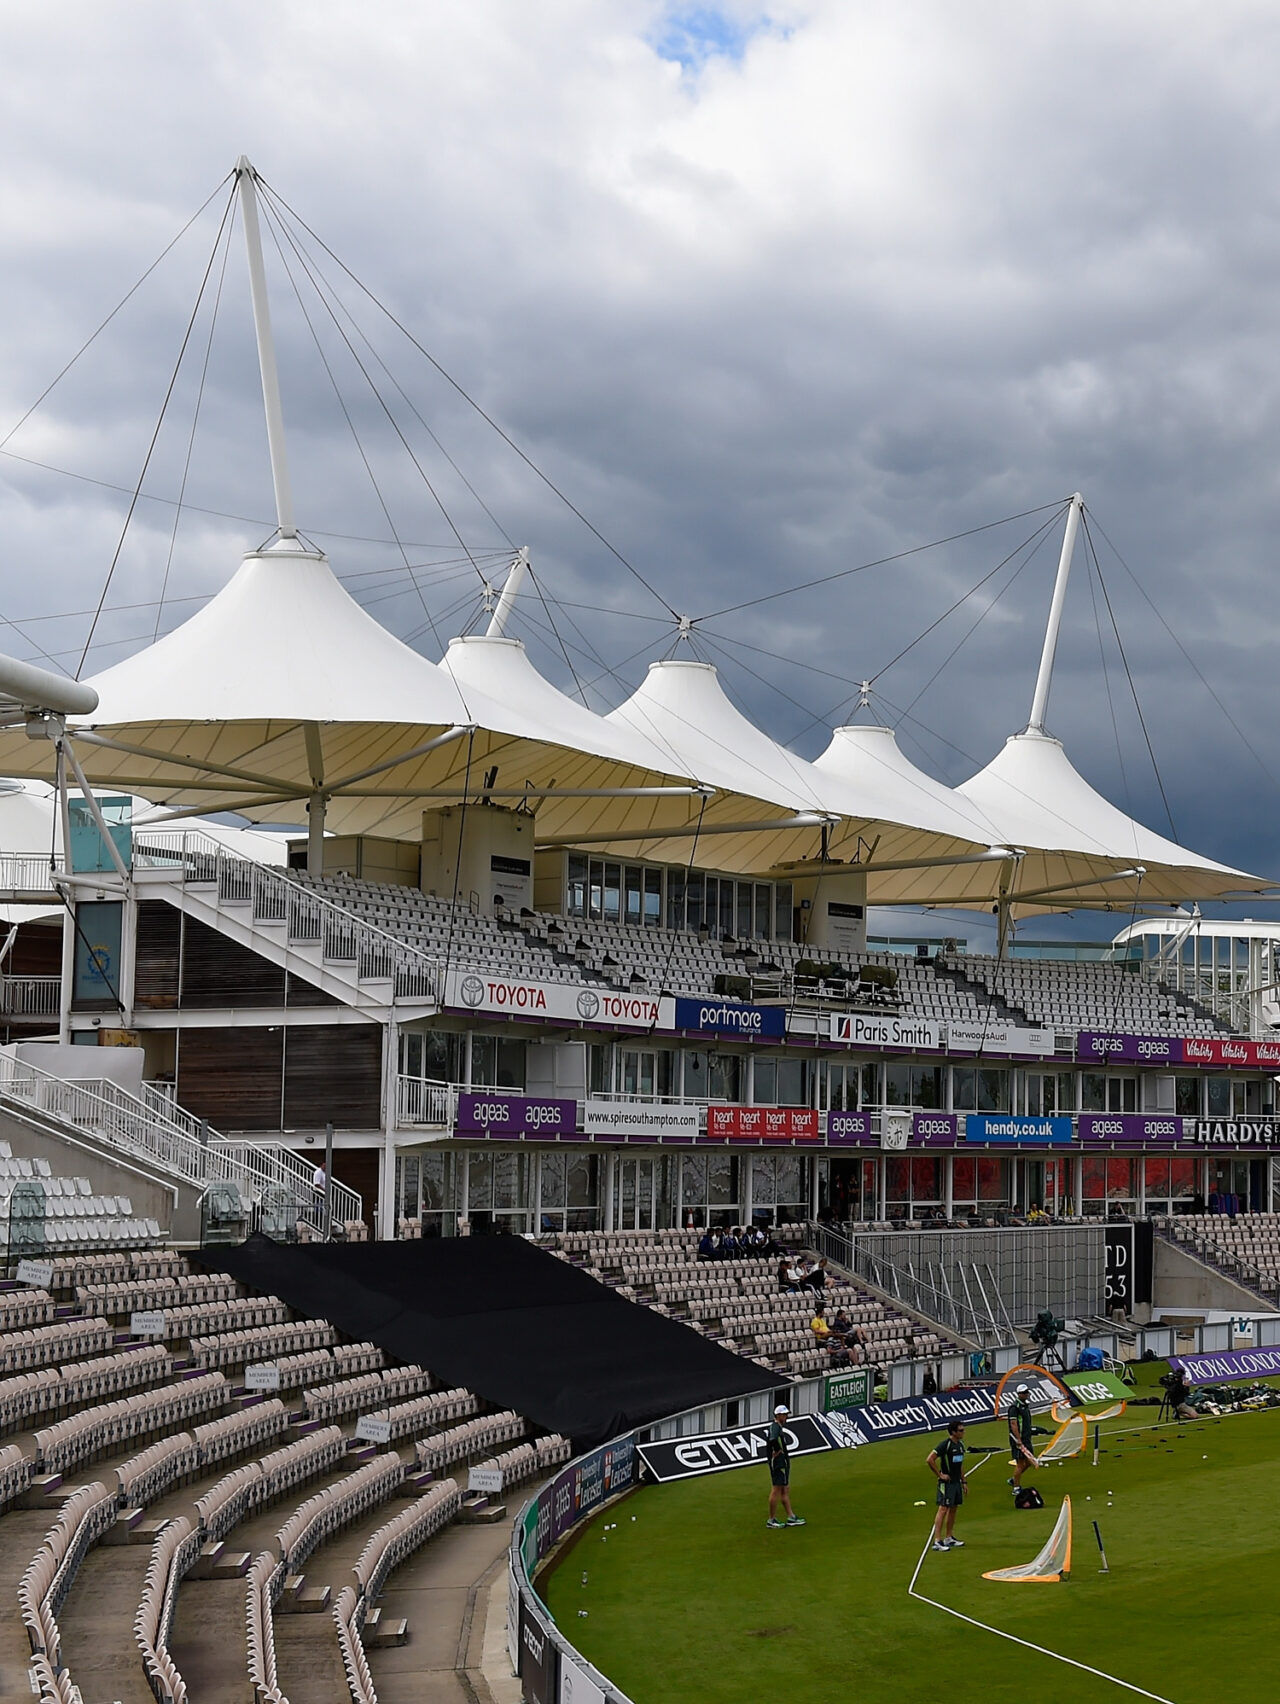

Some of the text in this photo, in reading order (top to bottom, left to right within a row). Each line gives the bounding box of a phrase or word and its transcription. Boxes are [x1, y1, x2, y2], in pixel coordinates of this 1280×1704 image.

[488, 983, 546, 1010] TOYOTA
[602, 997, 659, 1021] TOYOTA
[700, 1004, 762, 1028] portmore
[855, 1018, 932, 1046] Paris Smith
[1091, 1038, 1124, 1055] ageas
[1138, 1041, 1170, 1059] ageas
[1187, 1040, 1213, 1061] Vitality
[1221, 1042, 1248, 1063] Vitality
[473, 1103, 510, 1128] ageas
[525, 1105, 561, 1130] ageas
[588, 1111, 696, 1128] www.spiresouthampton.com
[713, 1109, 734, 1123] heart
[740, 1110, 760, 1124] heart
[766, 1111, 786, 1125] heart
[792, 1112, 812, 1125] heart
[832, 1117, 865, 1138] ageas
[917, 1119, 951, 1139] ageas
[985, 1120, 1053, 1138] hendy.co.uk
[1091, 1120, 1123, 1139] ageas
[1144, 1121, 1175, 1139] ageas
[1198, 1123, 1272, 1143] HARDYS
[1188, 1357, 1238, 1379] ROYAL
[830, 1380, 865, 1399] EASTLEIGH
[1070, 1382, 1114, 1402] rose
[859, 1402, 932, 1431] Liberty
[922, 1389, 990, 1420] Mutual
